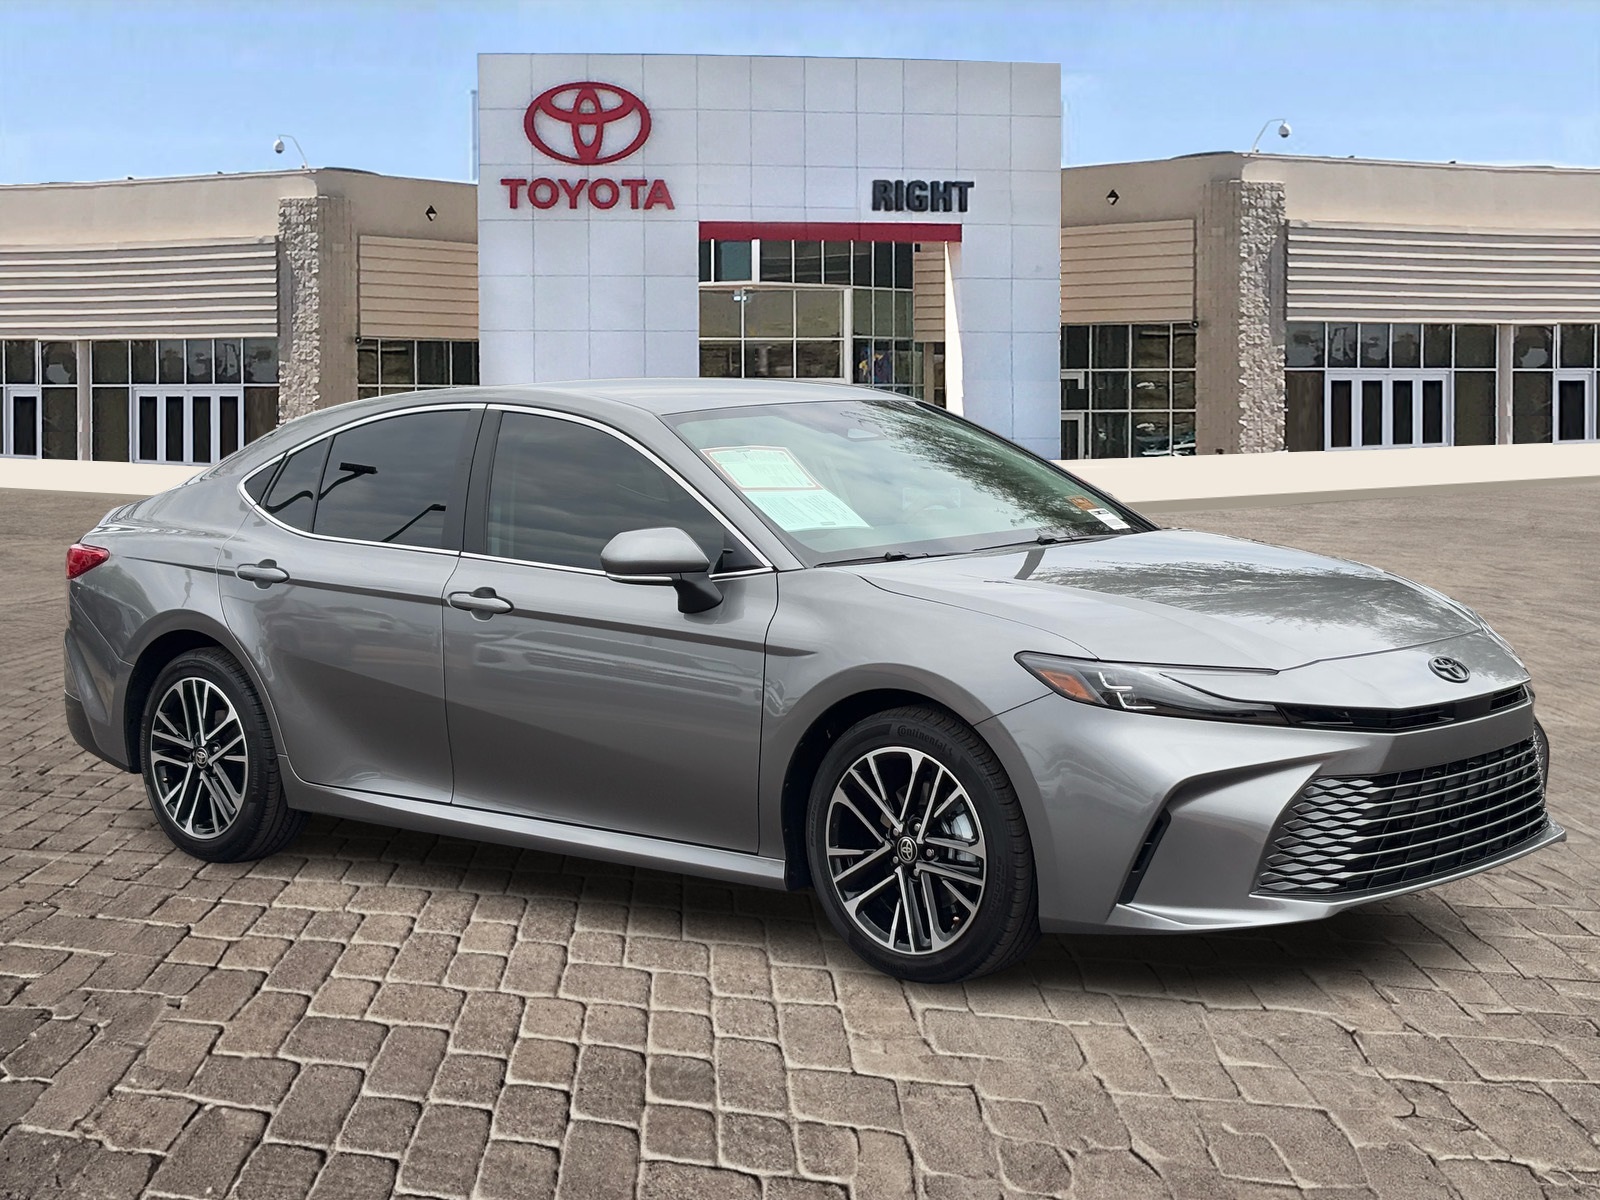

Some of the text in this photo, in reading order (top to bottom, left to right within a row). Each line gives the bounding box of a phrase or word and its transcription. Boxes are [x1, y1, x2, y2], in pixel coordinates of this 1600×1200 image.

[500, 178, 675, 210] TOYOTA
[872, 180, 974, 212] RIGHT
[897, 725, 947, 752] Continental
